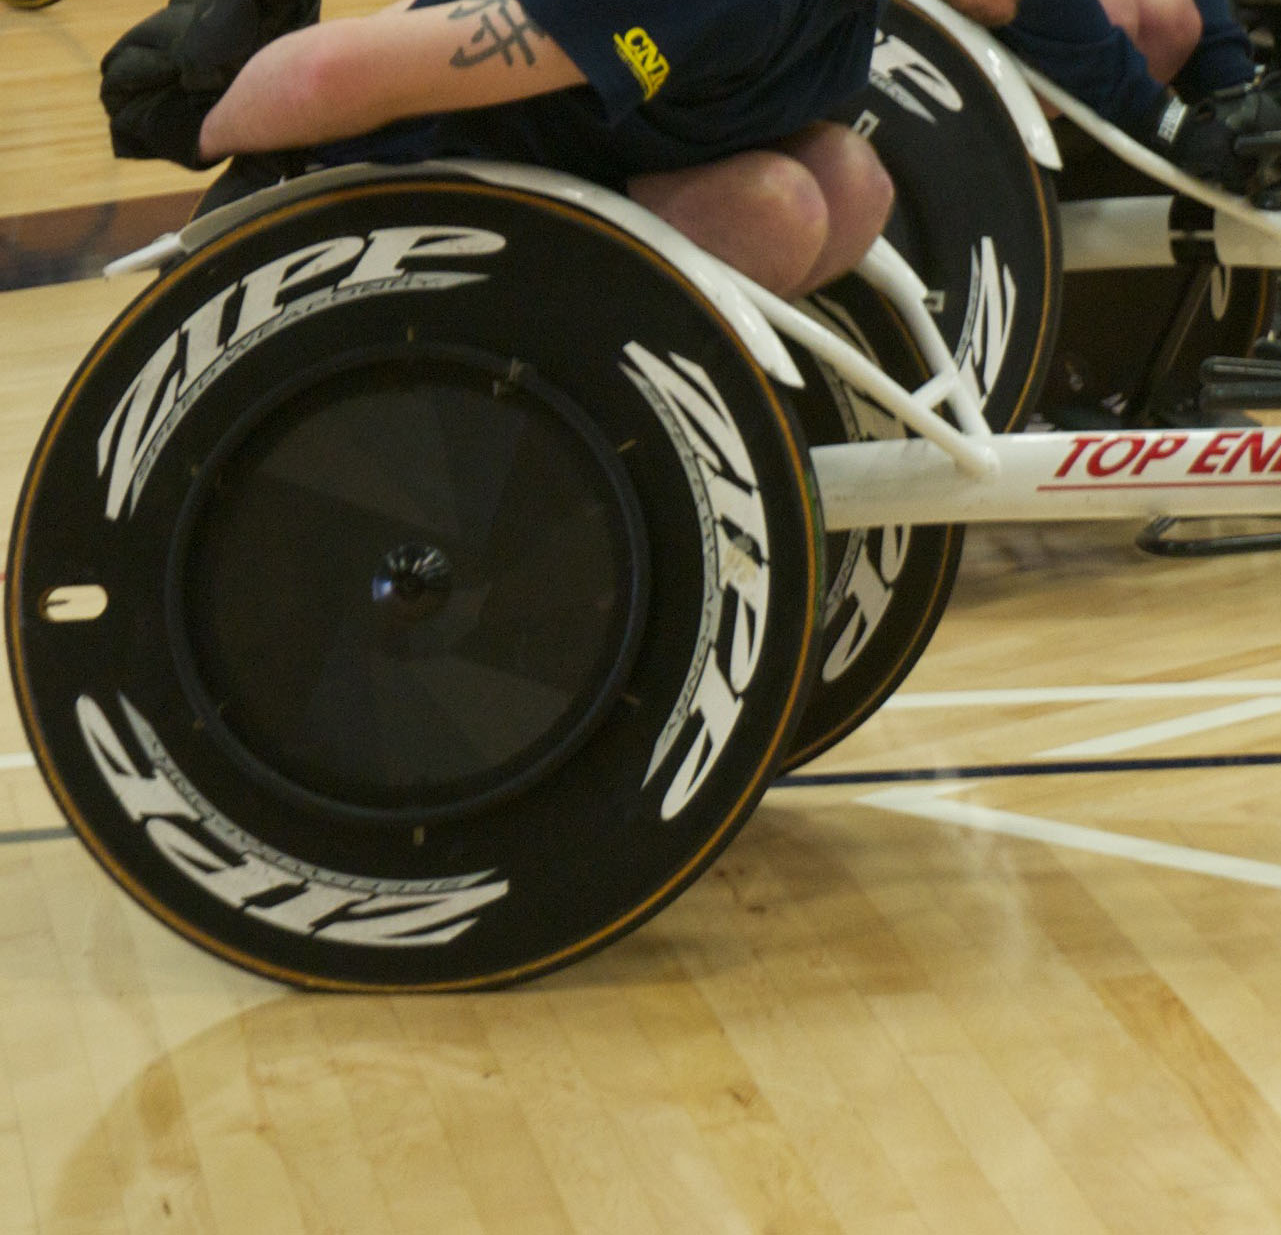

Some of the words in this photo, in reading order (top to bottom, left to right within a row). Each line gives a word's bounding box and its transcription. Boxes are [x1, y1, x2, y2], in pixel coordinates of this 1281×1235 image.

[97, 226, 507, 522] ZIPP
[1054, 434, 1188, 478] TOP
[622, 340, 770, 822] ZIPP
[75, 694, 510, 948] ZIPP
